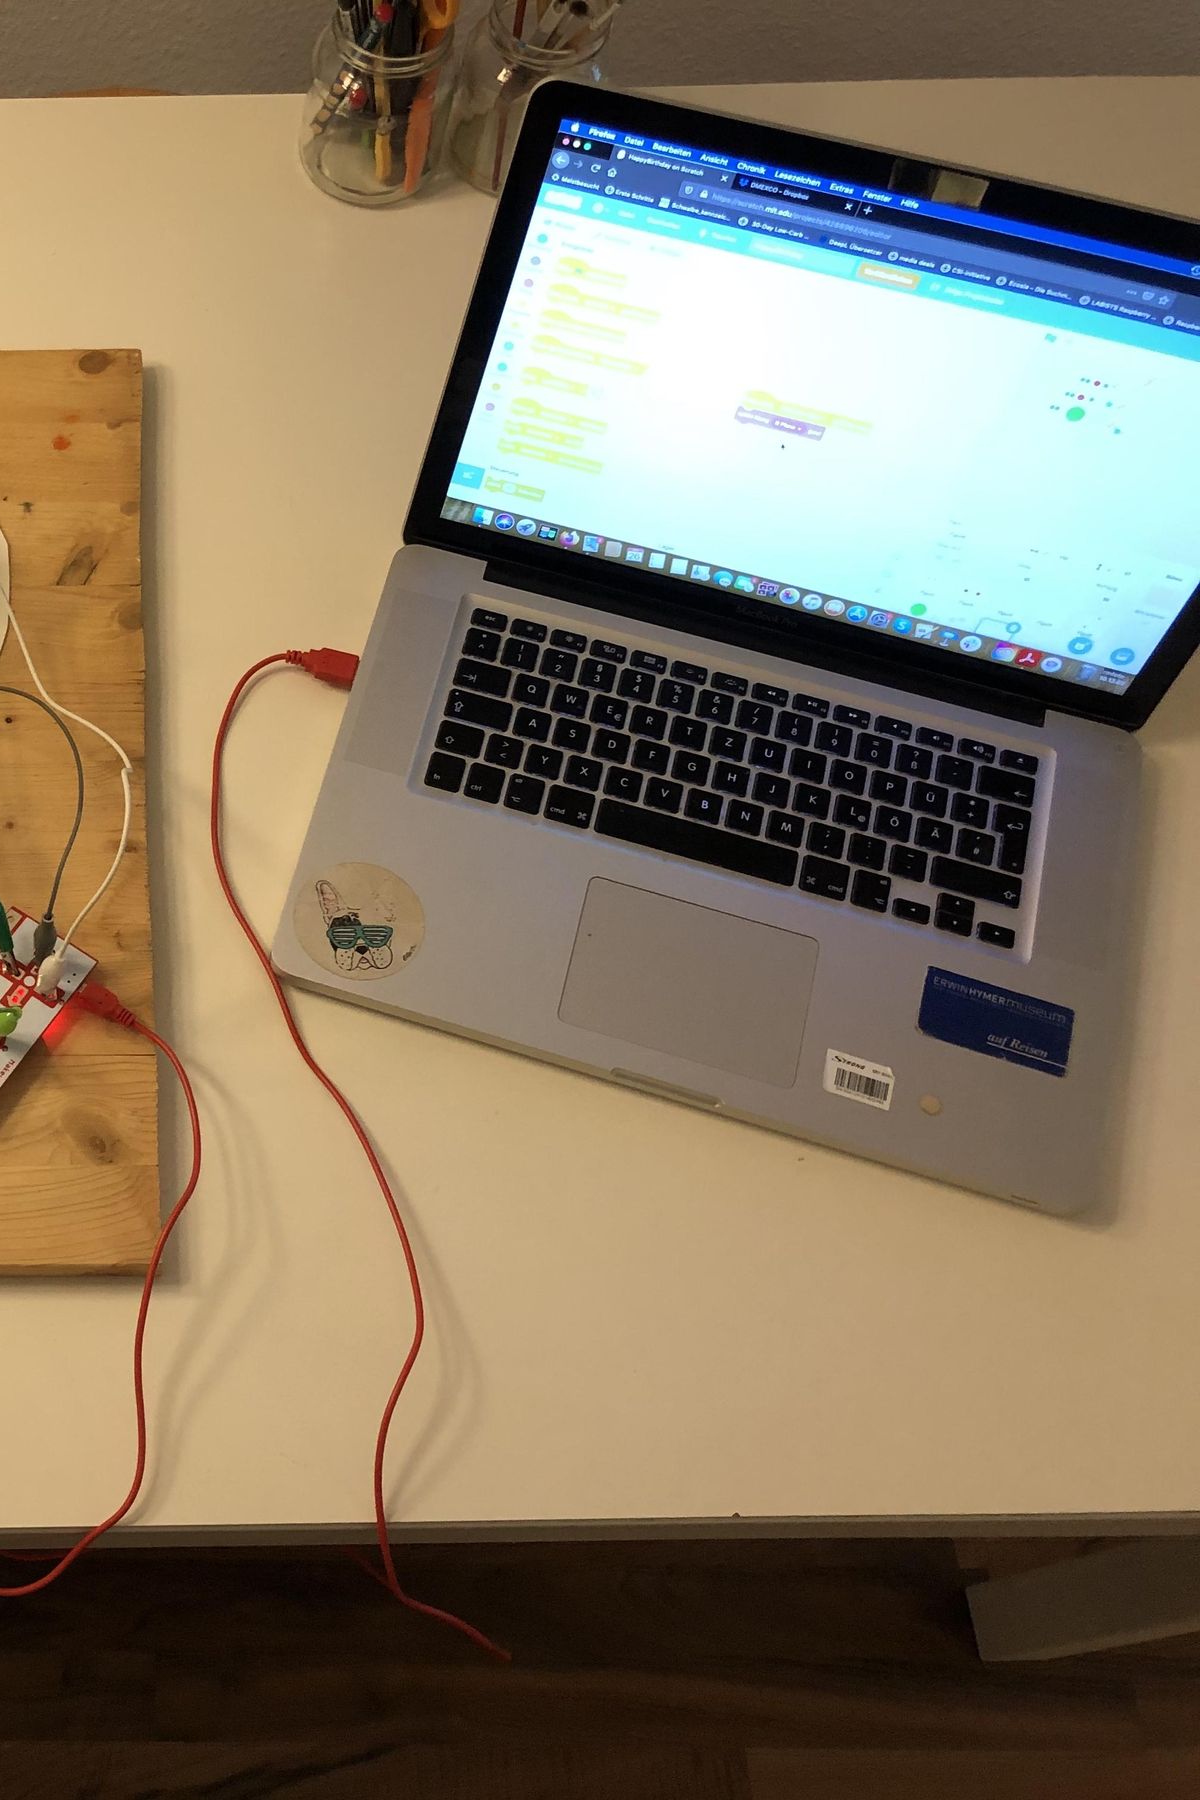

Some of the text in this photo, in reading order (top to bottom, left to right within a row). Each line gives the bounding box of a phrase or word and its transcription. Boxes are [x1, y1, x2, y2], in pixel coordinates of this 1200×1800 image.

[589, 127, 919, 210] Firefox Datei Bearbeiten Ansicht Chronik Lesezeichen Extras Fenster Hilfe
[679, 164, 704, 177] Scratch
[750, 180, 777, 194] DMEXCO
[783, 188, 810, 201] Dropbox
[615, 187, 630, 198] Erste
[631, 190, 654, 203] Schritte
[899, 255, 918, 266] media
[919, 258, 936, 269] deals
[527, 684, 537, 694] Q
[566, 695, 577, 704] W
[606, 706, 613, 714] E
[528, 718, 537, 728] A
[646, 716, 654, 725] R
[569, 729, 576, 738] S
[686, 727, 694, 736] T
[608, 740, 616, 749] D
[724, 738, 734, 747] Z
[648, 750, 656, 759] F
[764, 749, 773, 759] U
[541, 756, 548, 765] Y
[580, 766, 588, 776] X
[688, 762, 696, 772] G
[620, 777, 629, 787] C
[727, 772, 737, 782] H
[470, 784, 482, 792] ctrl
[769, 784, 776, 794] J
[886, 782, 894, 791] P
[661, 788, 669, 798] V
[702, 800, 709, 810] B
[808, 795, 818, 805] K
[550, 806, 566, 815] cmd
[741, 811, 750, 820] N
[850, 807, 858, 816] L
[781, 822, 792, 833] M
[828, 883, 843, 894] cmd
[987, 1033, 1048, 1058] auf Reisen
